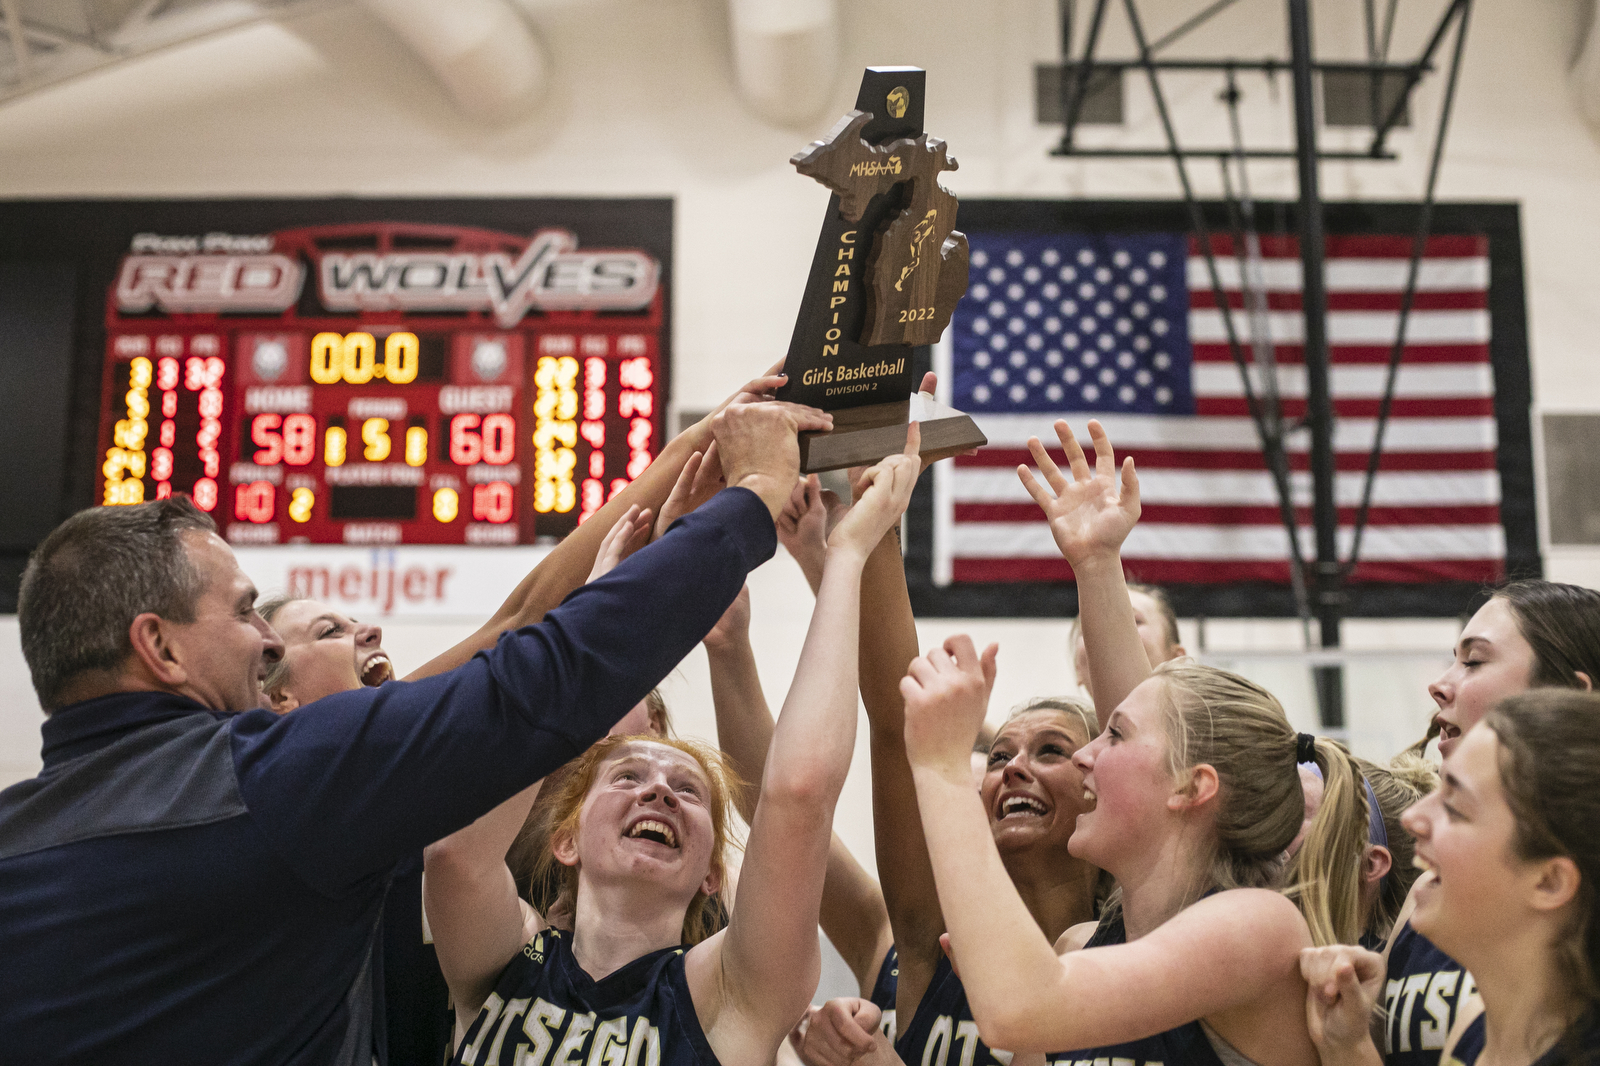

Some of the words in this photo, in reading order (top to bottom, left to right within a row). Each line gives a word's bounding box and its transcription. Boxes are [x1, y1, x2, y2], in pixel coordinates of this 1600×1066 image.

[849, 160, 896, 177] MHSAA
[121, 256, 297, 304] RED
[323, 232, 655, 324] WOLVES
[822, 230, 857, 357] CHAMPION
[899, 307, 936, 323] 2022
[310, 332, 419, 384] 00.0
[802, 364, 833, 386] Girls
[836, 358, 905, 383] Basketball
[825, 383, 869, 396] DIVISION
[871, 382, 878, 391] 2
[251, 413, 317, 466] 58
[361, 417, 392, 462] 5
[450, 413, 516, 466] 60
[288, 551, 452, 616] meijer
